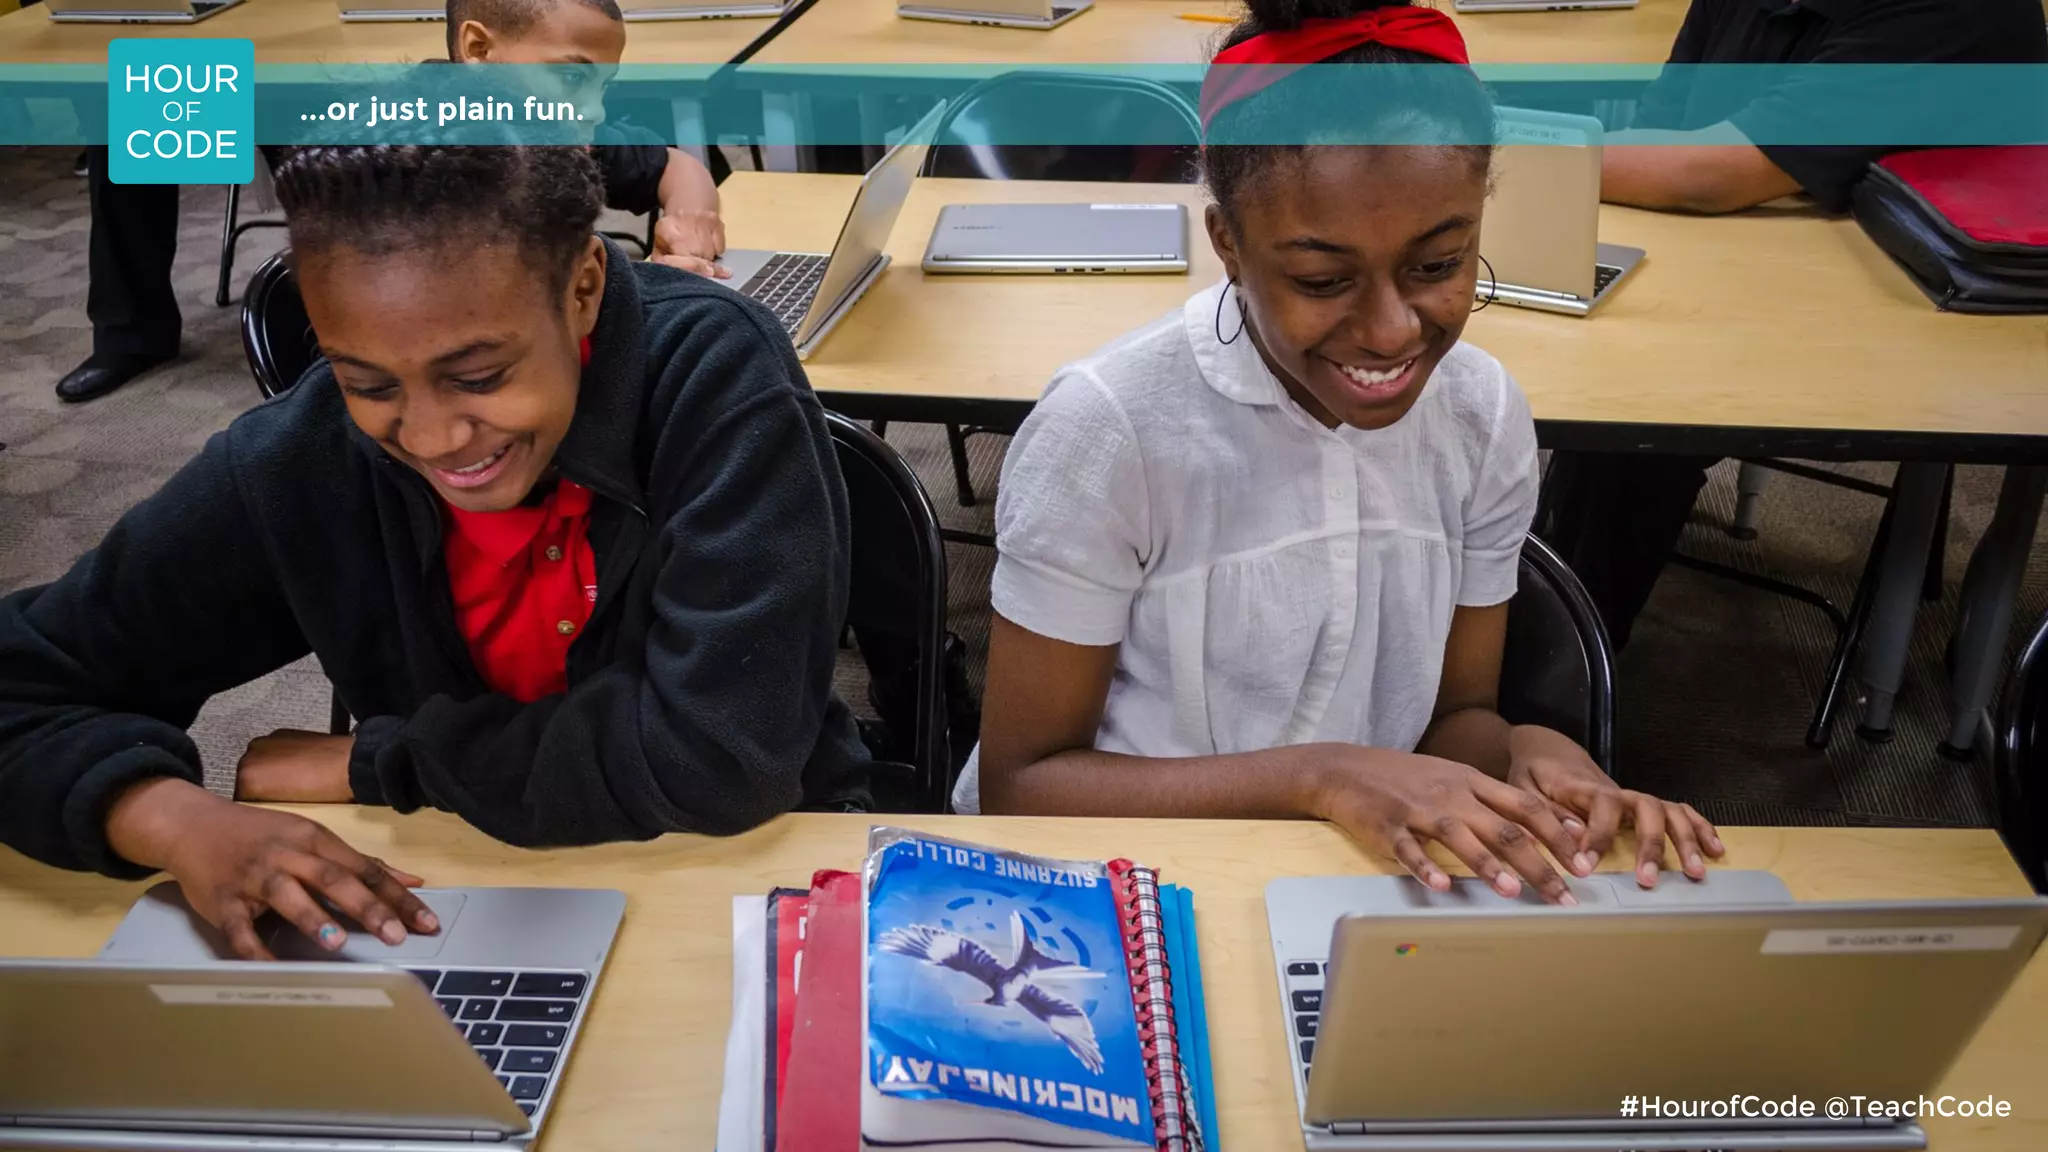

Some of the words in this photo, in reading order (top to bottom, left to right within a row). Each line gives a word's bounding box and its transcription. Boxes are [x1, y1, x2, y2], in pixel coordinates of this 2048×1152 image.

[896, 841, 987, 871] COLLI
[995, 856, 1099, 888] SUZANNE
[884, 1056, 1140, 1125] MOCKINGJAY
